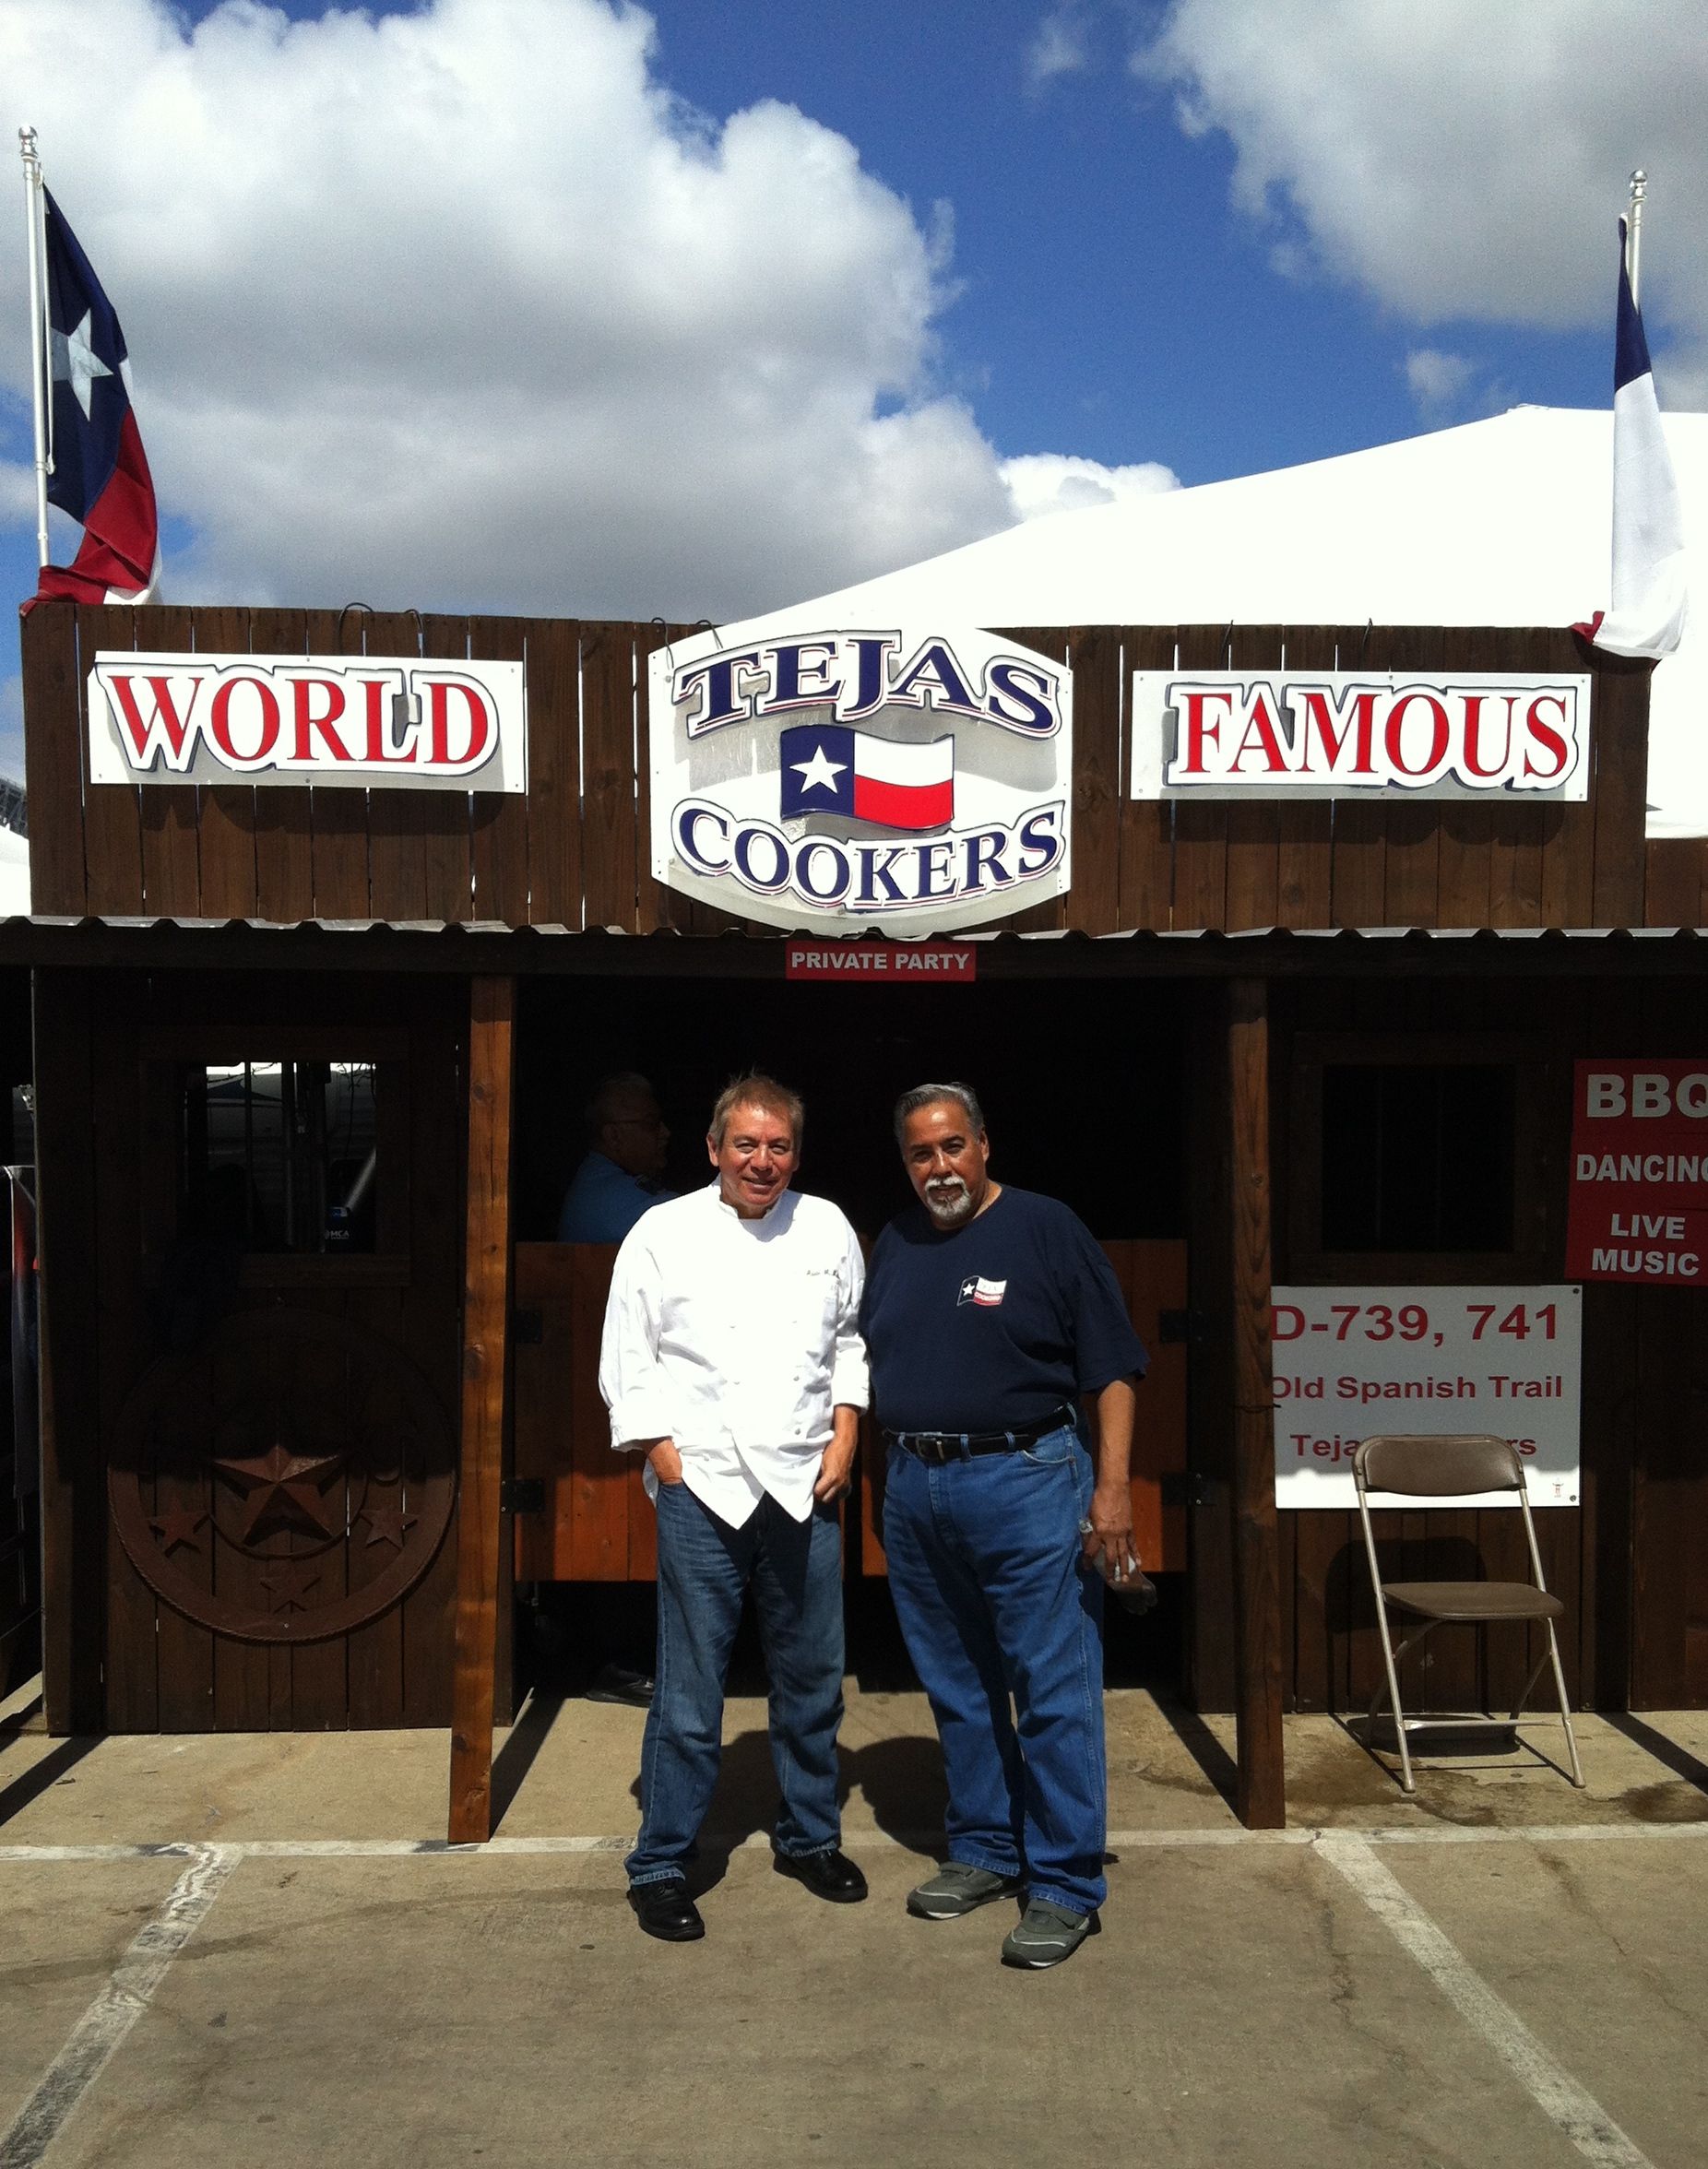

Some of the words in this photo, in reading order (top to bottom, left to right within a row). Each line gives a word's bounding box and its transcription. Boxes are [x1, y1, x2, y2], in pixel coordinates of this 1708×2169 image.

[678, 638, 1058, 733] TEJAS
[106, 675, 489, 764] WORLD
[1178, 692, 1571, 778] FAMOUS
[677, 806, 1059, 904] COOKERS
[791, 952, 887, 969] PRIVATE
[895, 953, 969, 970] PARTY
[1586, 1073, 1708, 1119] BBQ
[1610, 1214, 1687, 1239] LIVE
[1591, 1248, 1700, 1276] MUSIC
[1270, 1304, 1444, 1347] D-739,
[1465, 1303, 1557, 1341] 741
[1272, 1376, 1324, 1398] Old
[1336, 1375, 1477, 1404] Spanish
[1488, 1375, 1563, 1398] Trail
[1289, 1434, 1360, 1463] Teja
